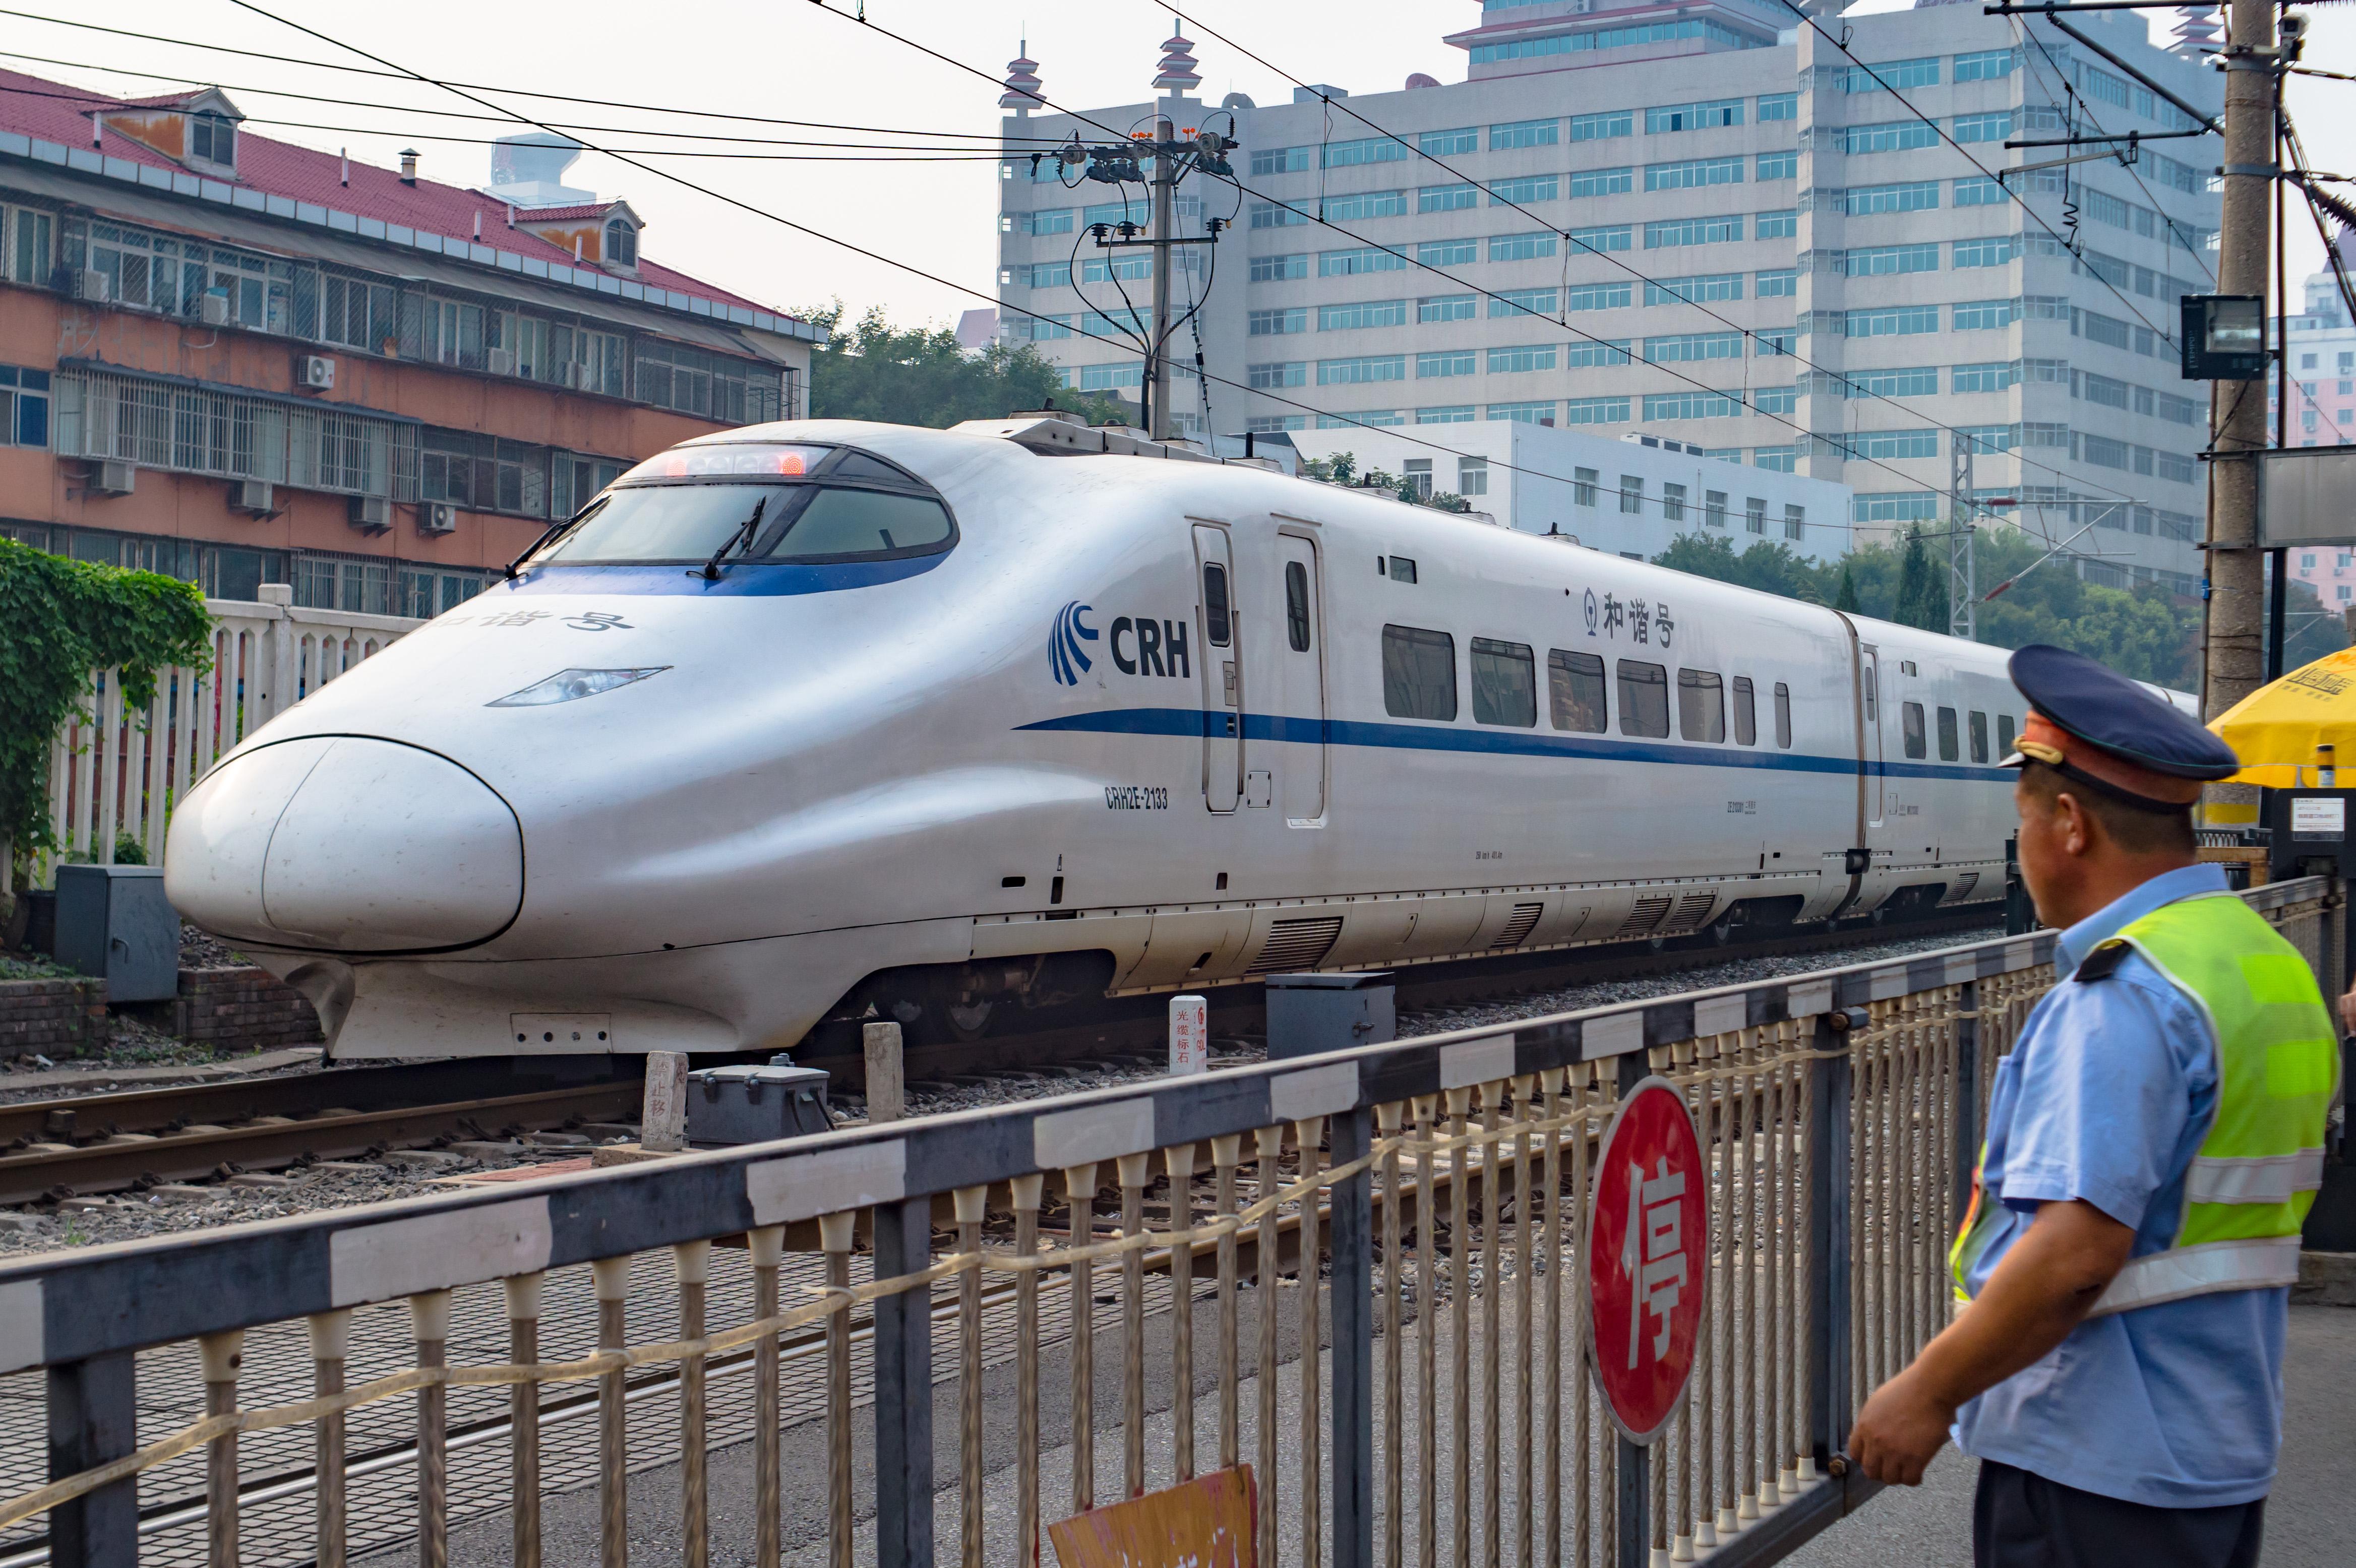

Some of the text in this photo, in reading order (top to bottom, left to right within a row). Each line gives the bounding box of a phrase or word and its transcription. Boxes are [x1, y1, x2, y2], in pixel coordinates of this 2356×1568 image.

[1110, 616, 1190, 678] CRH
[1604, 592, 1674, 649] 和谐号
[1105, 786, 1168, 809] CRH2E-2133
[1176, 1010, 1189, 1063] 光缆标石
[1620, 1155, 1687, 1370] 停
